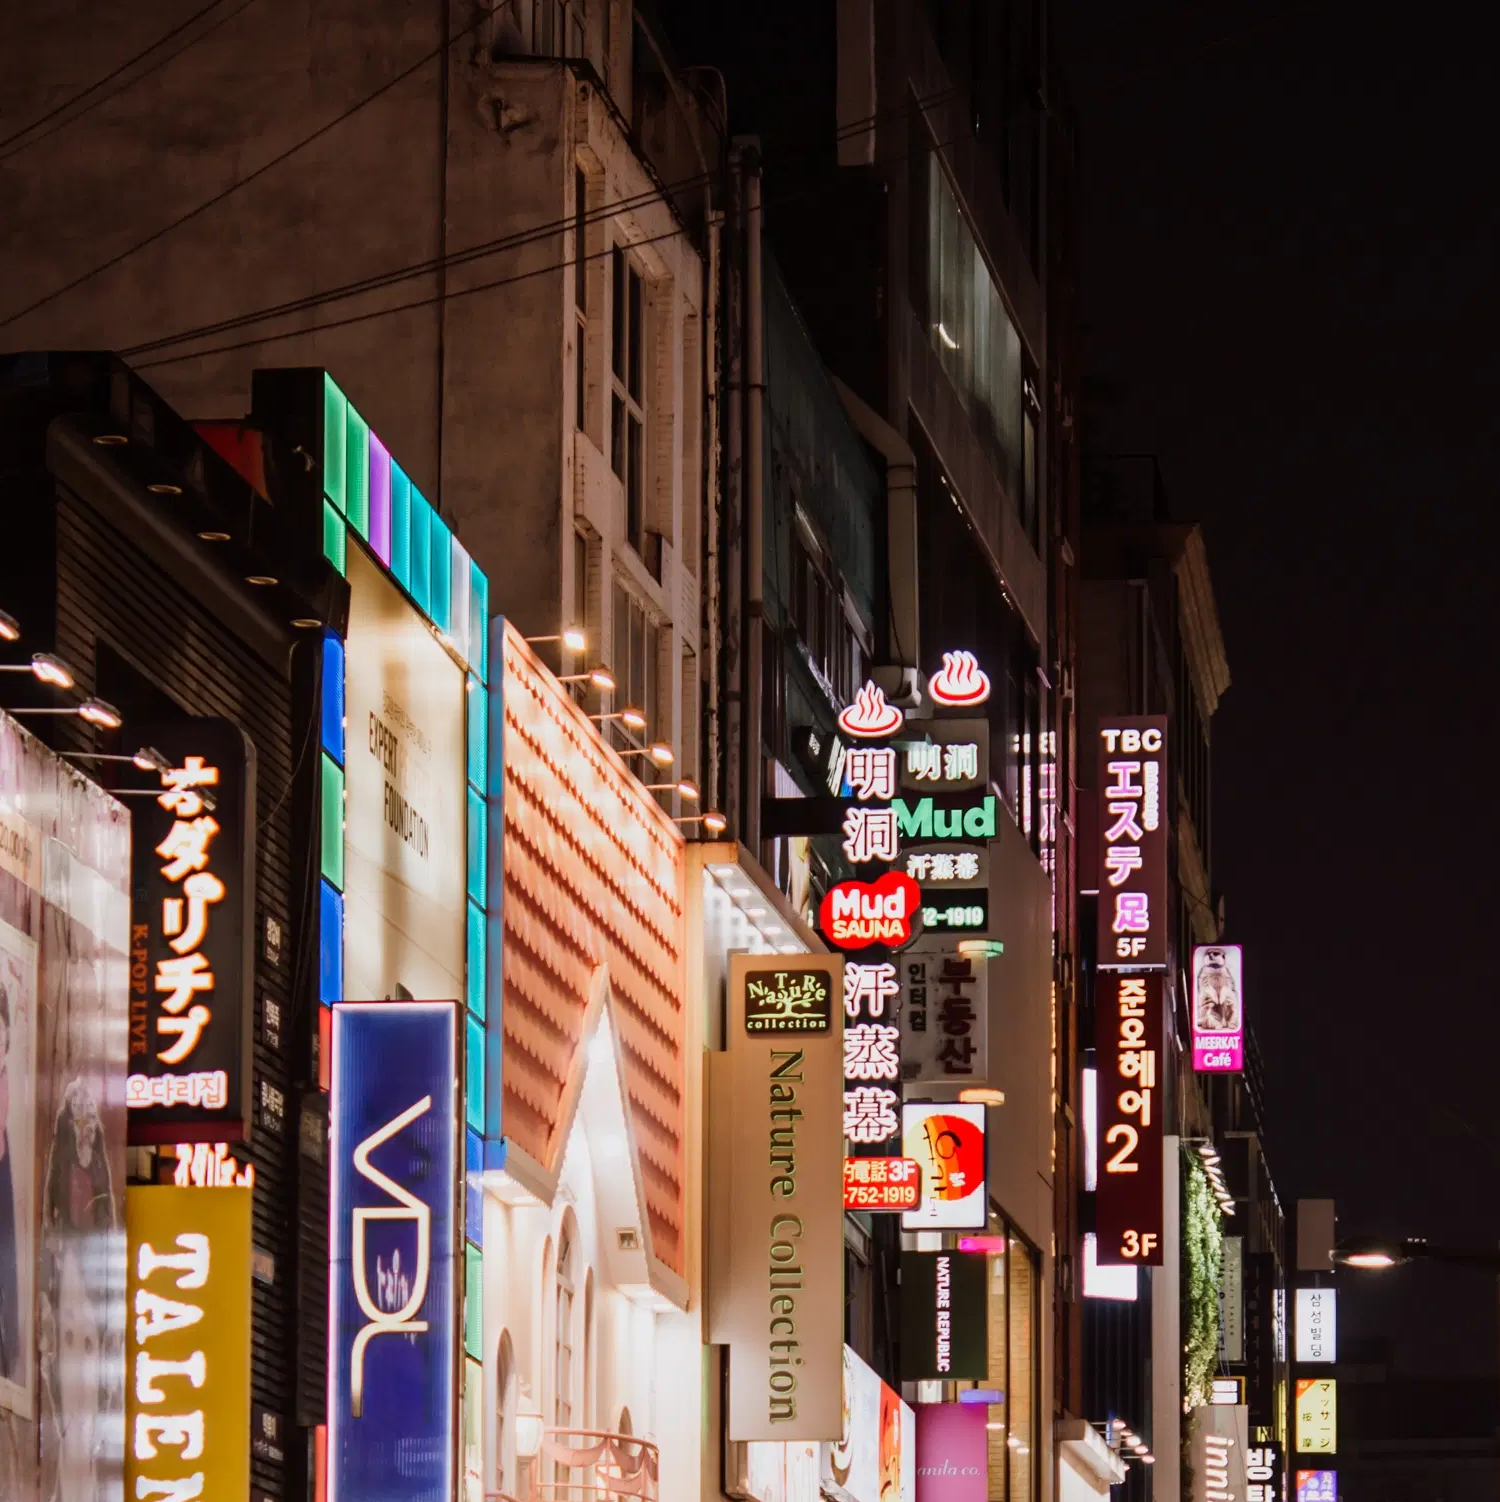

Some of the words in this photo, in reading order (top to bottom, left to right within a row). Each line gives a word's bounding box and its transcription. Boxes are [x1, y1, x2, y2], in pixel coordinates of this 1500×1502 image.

[1101, 728, 1162, 753] TBC
[906, 743, 978, 781] 明洞
[843, 747, 898, 862] 明洞
[892, 796, 997, 838] Mud
[1105, 761, 1143, 887] エステ
[832, 886, 905, 921] Mud
[922, 906, 985, 927] 2-1919
[1112, 892, 1150, 934] 足
[832, 918, 905, 939] SAUNA
[1116, 937, 1147, 958] 5F
[132, 924, 148, 994] K-POP
[132, 1001, 147, 1055] LIVE
[746, 1019, 828, 1030] collection
[936, 957, 977, 1075] 부동산
[843, 961, 900, 1143] 汗蒸幕
[1117, 978, 1156, 1126] 준오헤어
[1195, 1034, 1241, 1051] MEERKAT
[1203, 1051, 1233, 1068] Café
[125, 1072, 228, 1110] 오다리집
[769, 1046, 804, 1199] Nature
[1105, 1125, 1140, 1174] 2
[888, 1159, 917, 1183] 3F
[845, 1186, 916, 1205] -752-1919
[350, 1094, 431, 1420] VDL
[1121, 1229, 1157, 1258] 3F
[936, 1257, 950, 1303] NATURE
[768, 1211, 804, 1425] Collection
[936, 1304, 950, 1373] REPUBLIC
[1309, 1292, 1323, 1358] 삼성빌딩
[916, 1458, 958, 1477] anila
